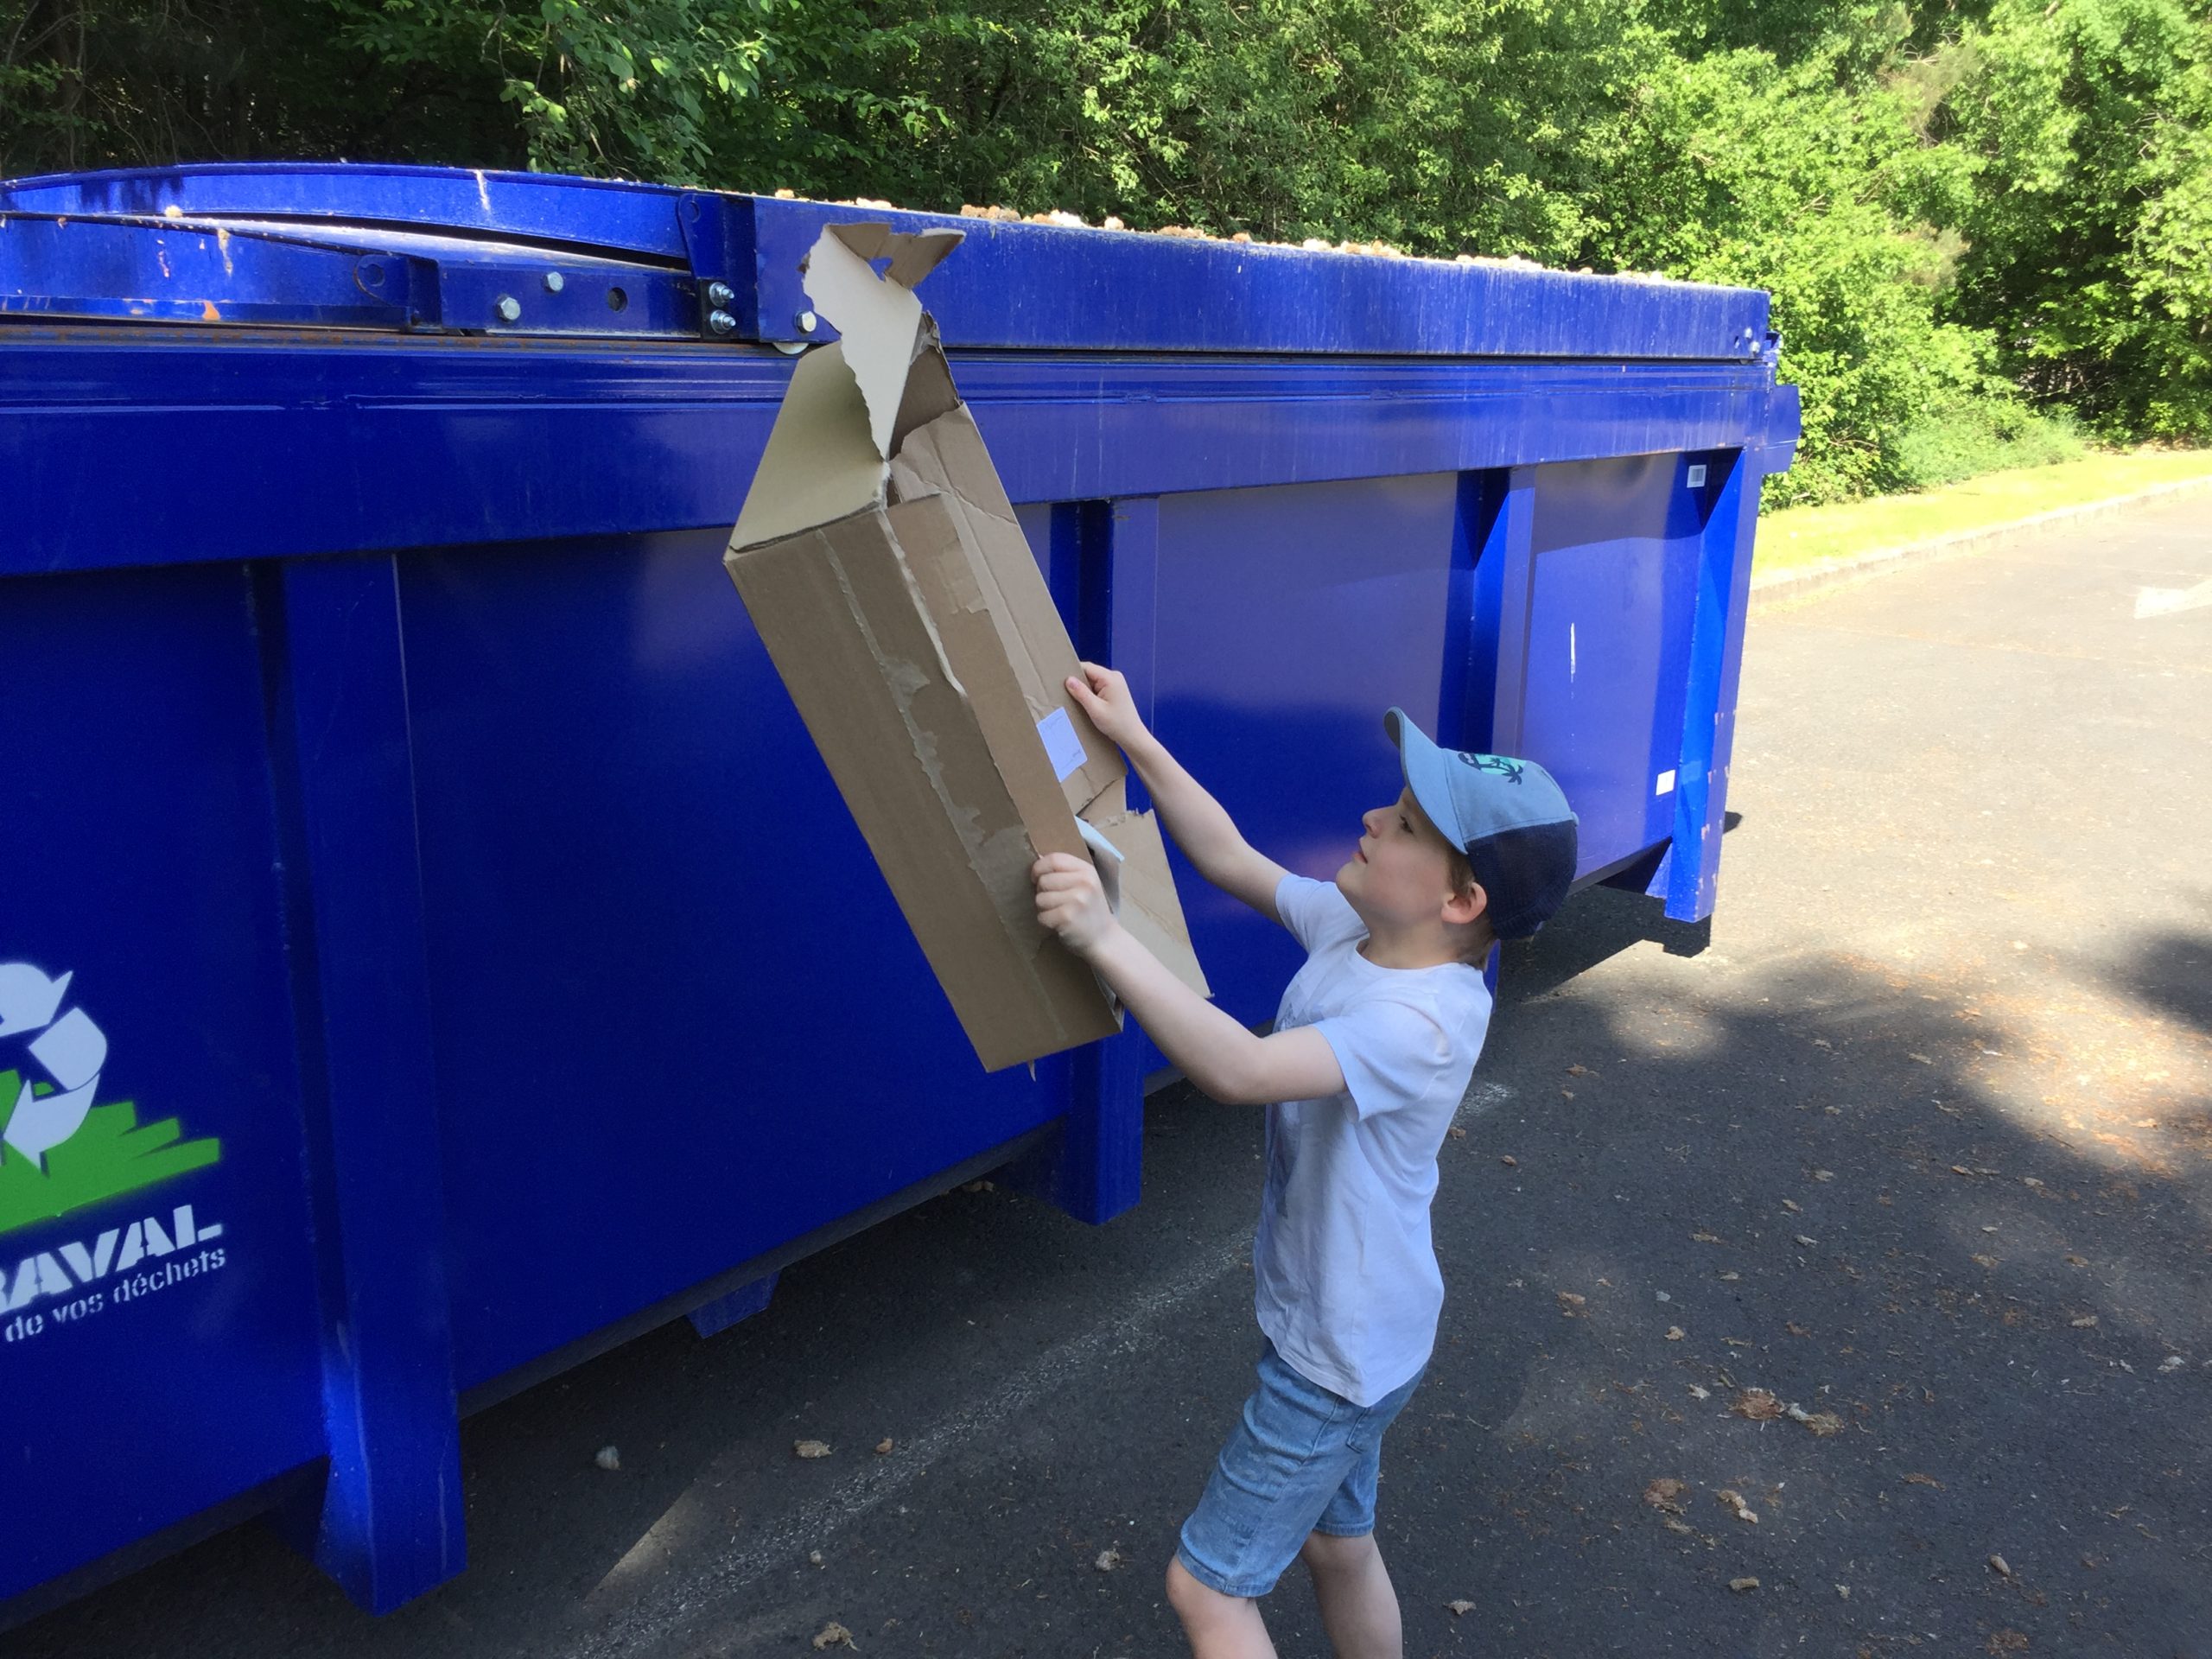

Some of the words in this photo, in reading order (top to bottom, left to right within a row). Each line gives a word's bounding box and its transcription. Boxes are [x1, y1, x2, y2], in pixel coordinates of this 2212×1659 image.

[0, 1204, 223, 1314] AVAL
[5, 1313, 43, 1342] de
[52, 1293, 104, 1324] vos
[113, 1248, 226, 1303] déchets
